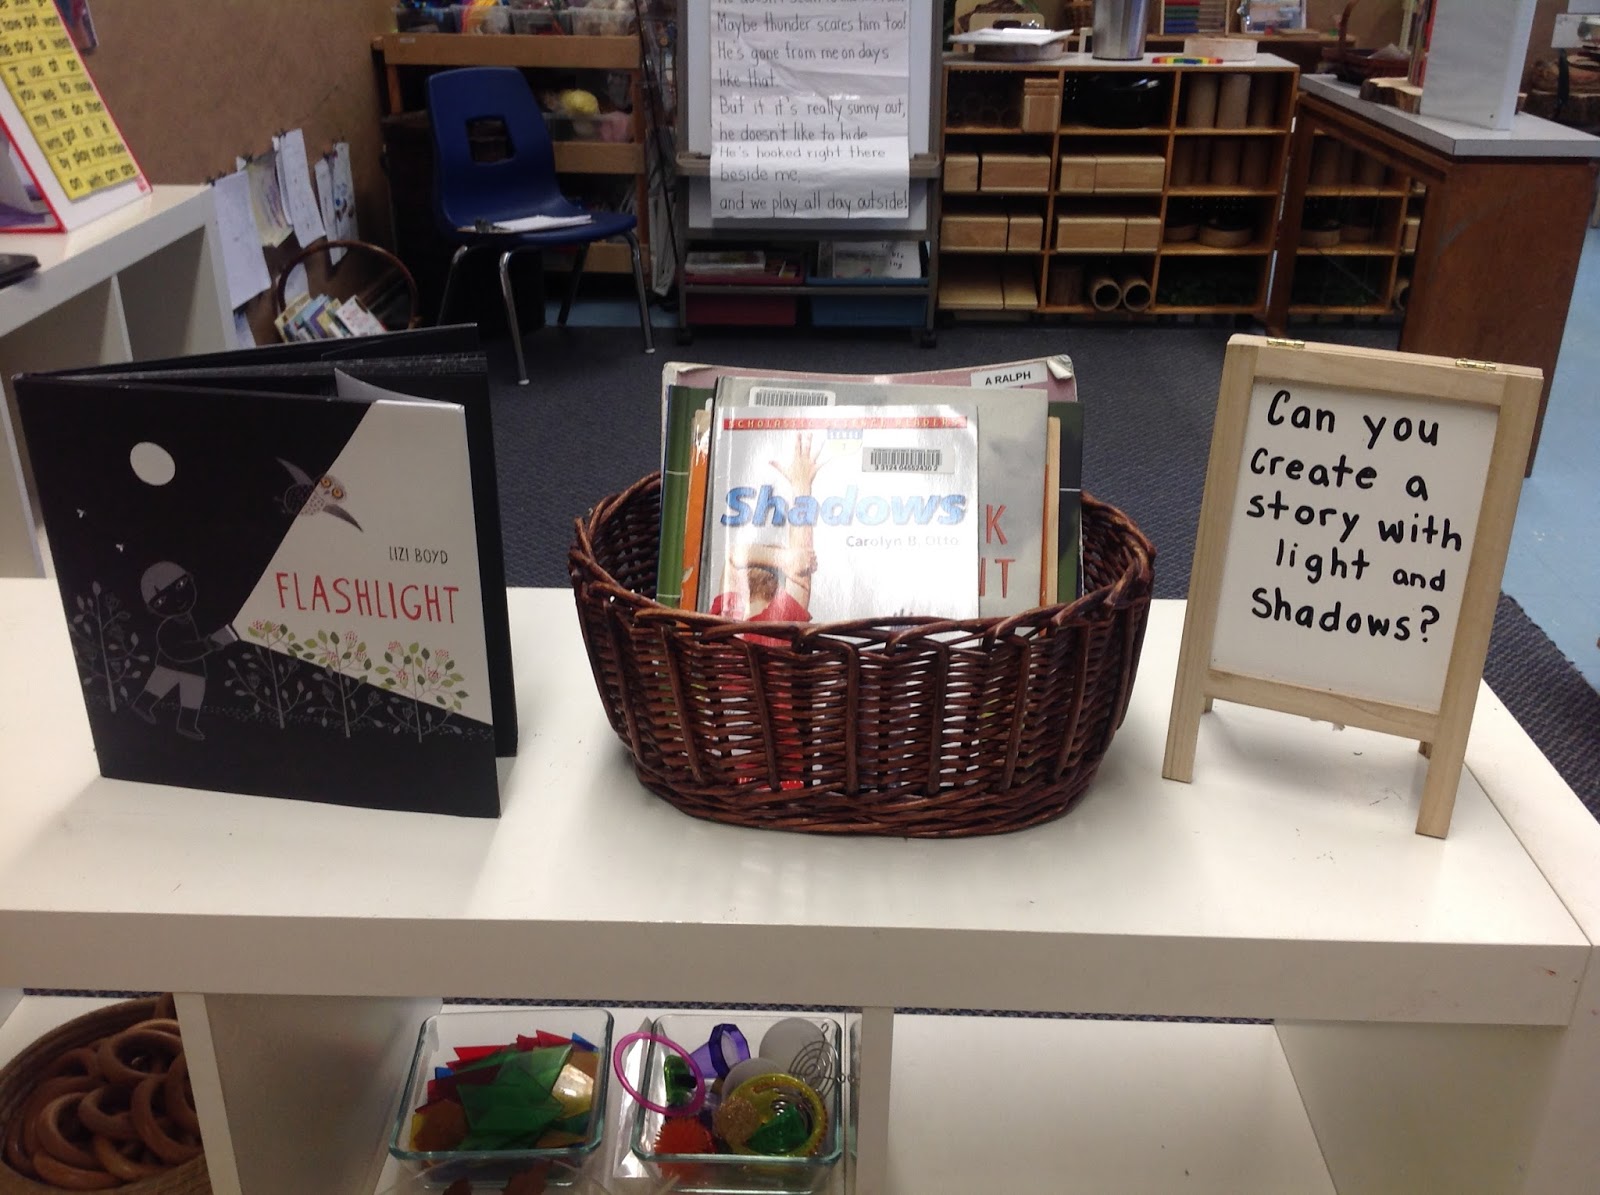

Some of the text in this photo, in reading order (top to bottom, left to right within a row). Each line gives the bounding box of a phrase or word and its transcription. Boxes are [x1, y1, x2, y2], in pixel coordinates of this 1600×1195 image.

[717, 11, 907, 39] Maybe thunder scares him too!
[717, 40, 889, 66] He's gone from me on days
[719, 68, 741, 88] like
[719, 95, 746, 115] But
[774, 96, 798, 116] it's
[807, 97, 842, 121] really
[848, 103, 880, 121] sunny
[719, 121, 868, 141] he doesn't like to hide
[720, 145, 886, 161] He's hooked right there
[720, 163, 769, 182] beside
[719, 189, 909, 218] and we play all day outside!
[984, 371, 1031, 386] A RALPH
[1266, 389, 1439, 450] Can you
[1405, 474, 1429, 502] a
[719, 484, 967, 528] Shadows
[1246, 489, 1462, 552] story with
[389, 545, 448, 565] LIZI BOYD
[845, 535, 903, 550] Carolyn
[925, 535, 960, 547] Otto
[1275, 538, 1446, 592] light and
[276, 572, 460, 624] FLASHLIGHT
